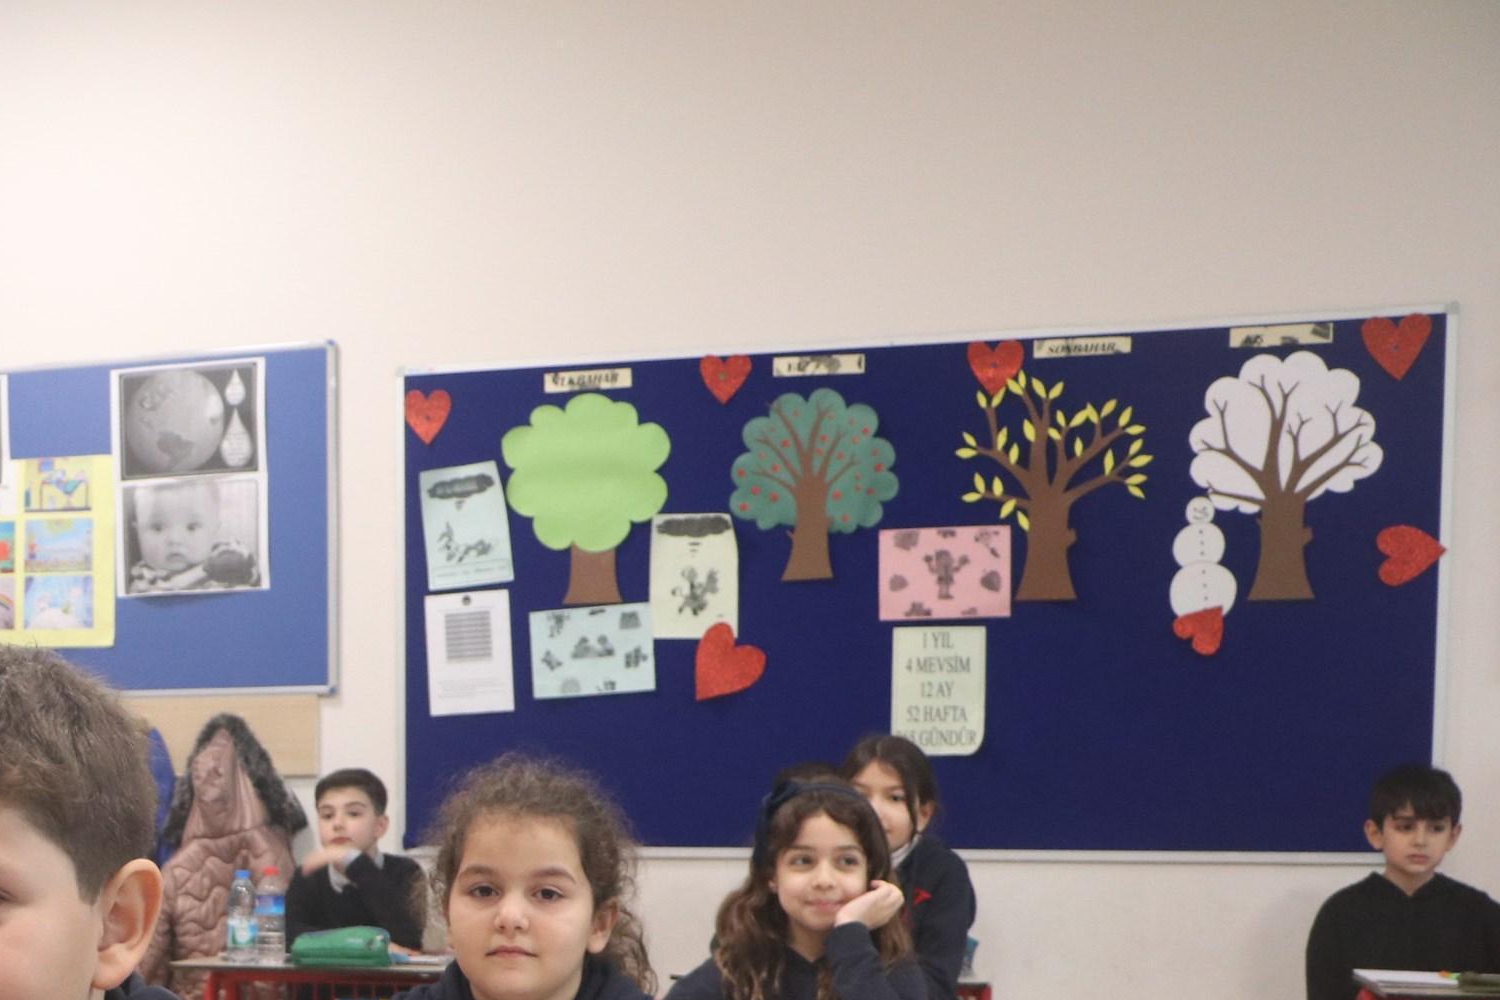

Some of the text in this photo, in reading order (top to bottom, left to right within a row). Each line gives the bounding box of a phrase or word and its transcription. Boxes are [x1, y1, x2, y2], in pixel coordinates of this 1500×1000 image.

[931, 631, 955, 649] YIL
[916, 653, 971, 673] MEVSİM
[921, 681, 954, 698] 12 AY
[906, 705, 969, 722] 52 HAFTA
[920, 726, 977, 746] GÜNDÜR
